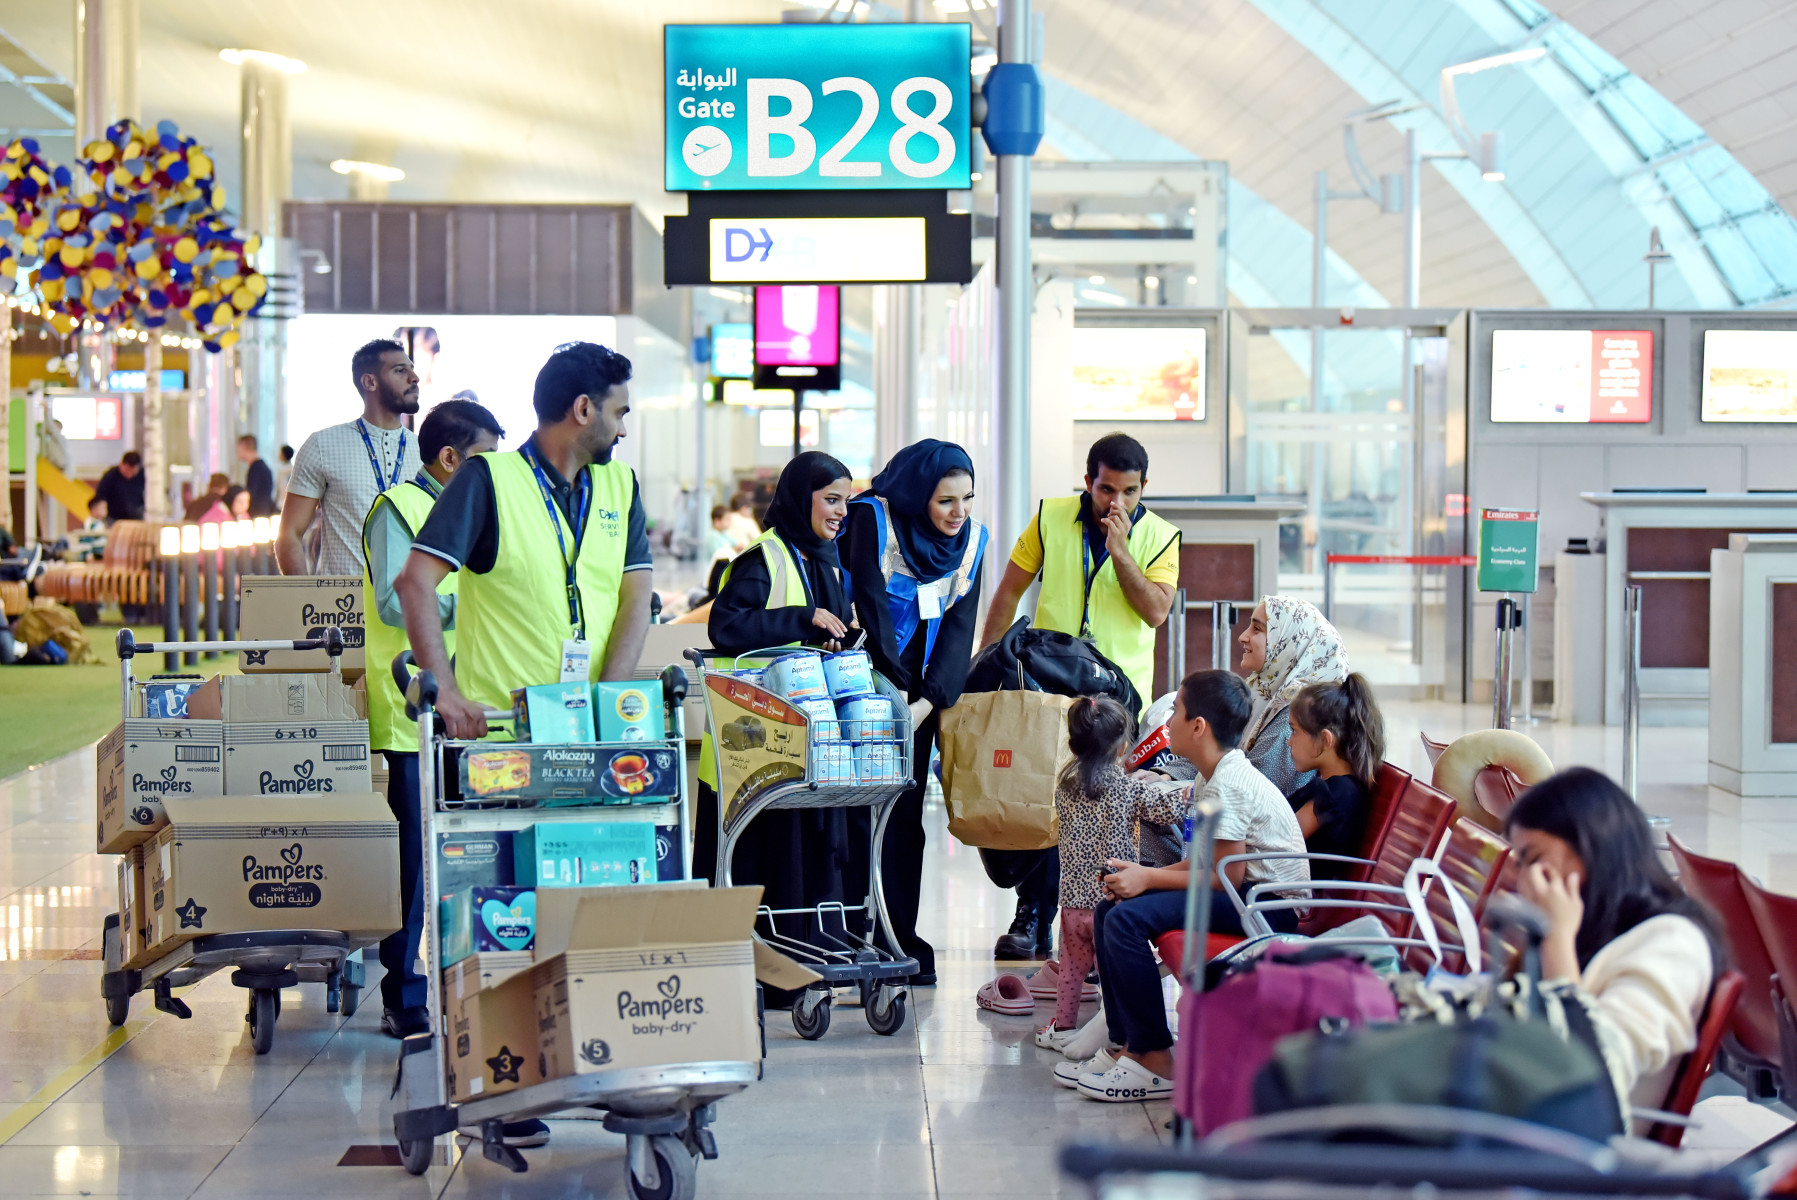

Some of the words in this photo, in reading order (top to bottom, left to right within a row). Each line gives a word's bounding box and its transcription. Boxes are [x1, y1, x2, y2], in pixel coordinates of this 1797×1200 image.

[677, 68, 737, 91] البوابة
[678, 97, 736, 119] Gate
[747, 77, 957, 178] B28
[302, 604, 365, 628] Pamper
[792, 665, 816, 674] Aptamil
[839, 663, 862, 672] Aptamil
[808, 708, 829, 716] Aptamil
[865, 707, 887, 715] Aptamil
[275, 729, 284, 740] 6
[288, 731, 296, 739] x
[302, 728, 317, 739] 10
[543, 750, 595, 764] Alokozay
[1129, 737, 1161, 763] Dubai
[542, 769, 574, 778] BLACK
[576, 769, 595, 778] TEA
[133, 774, 192, 795] Pampers
[260, 771, 333, 794] Pampers
[243, 855, 324, 885] Pampers
[256, 893, 285, 906] night
[186, 906, 197, 920] 4
[492, 912, 532, 927] Pampers
[499, 930, 513, 938] night
[617, 991, 704, 1020] Pampers
[976, 995, 992, 1008] rocs
[632, 1021, 692, 1036] baby-dry
[593, 1043, 604, 1058] 5
[500, 1055, 512, 1073] 3
[1105, 1088, 1147, 1098] crocs
